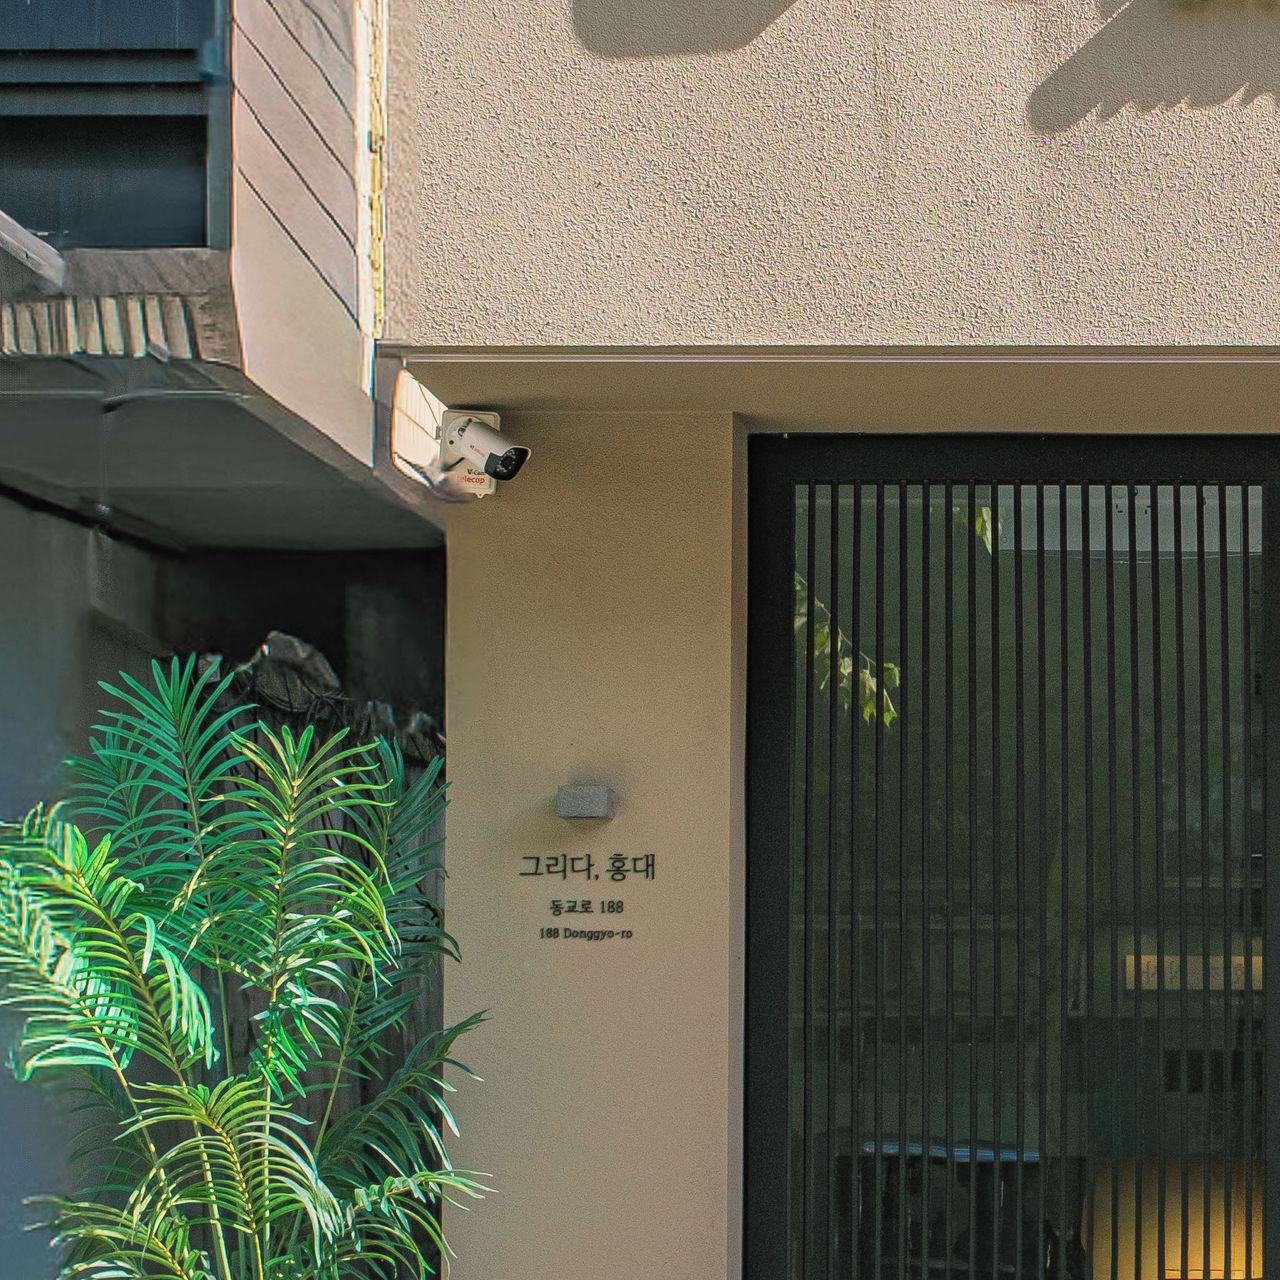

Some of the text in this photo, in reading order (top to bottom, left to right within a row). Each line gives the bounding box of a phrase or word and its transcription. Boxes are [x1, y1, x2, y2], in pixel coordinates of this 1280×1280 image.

[519, 853, 656, 882] 그리다, 홍대
[549, 899, 624, 916] 동교로 188
[539, 927, 633, 942] 188 Donggyo-ro
